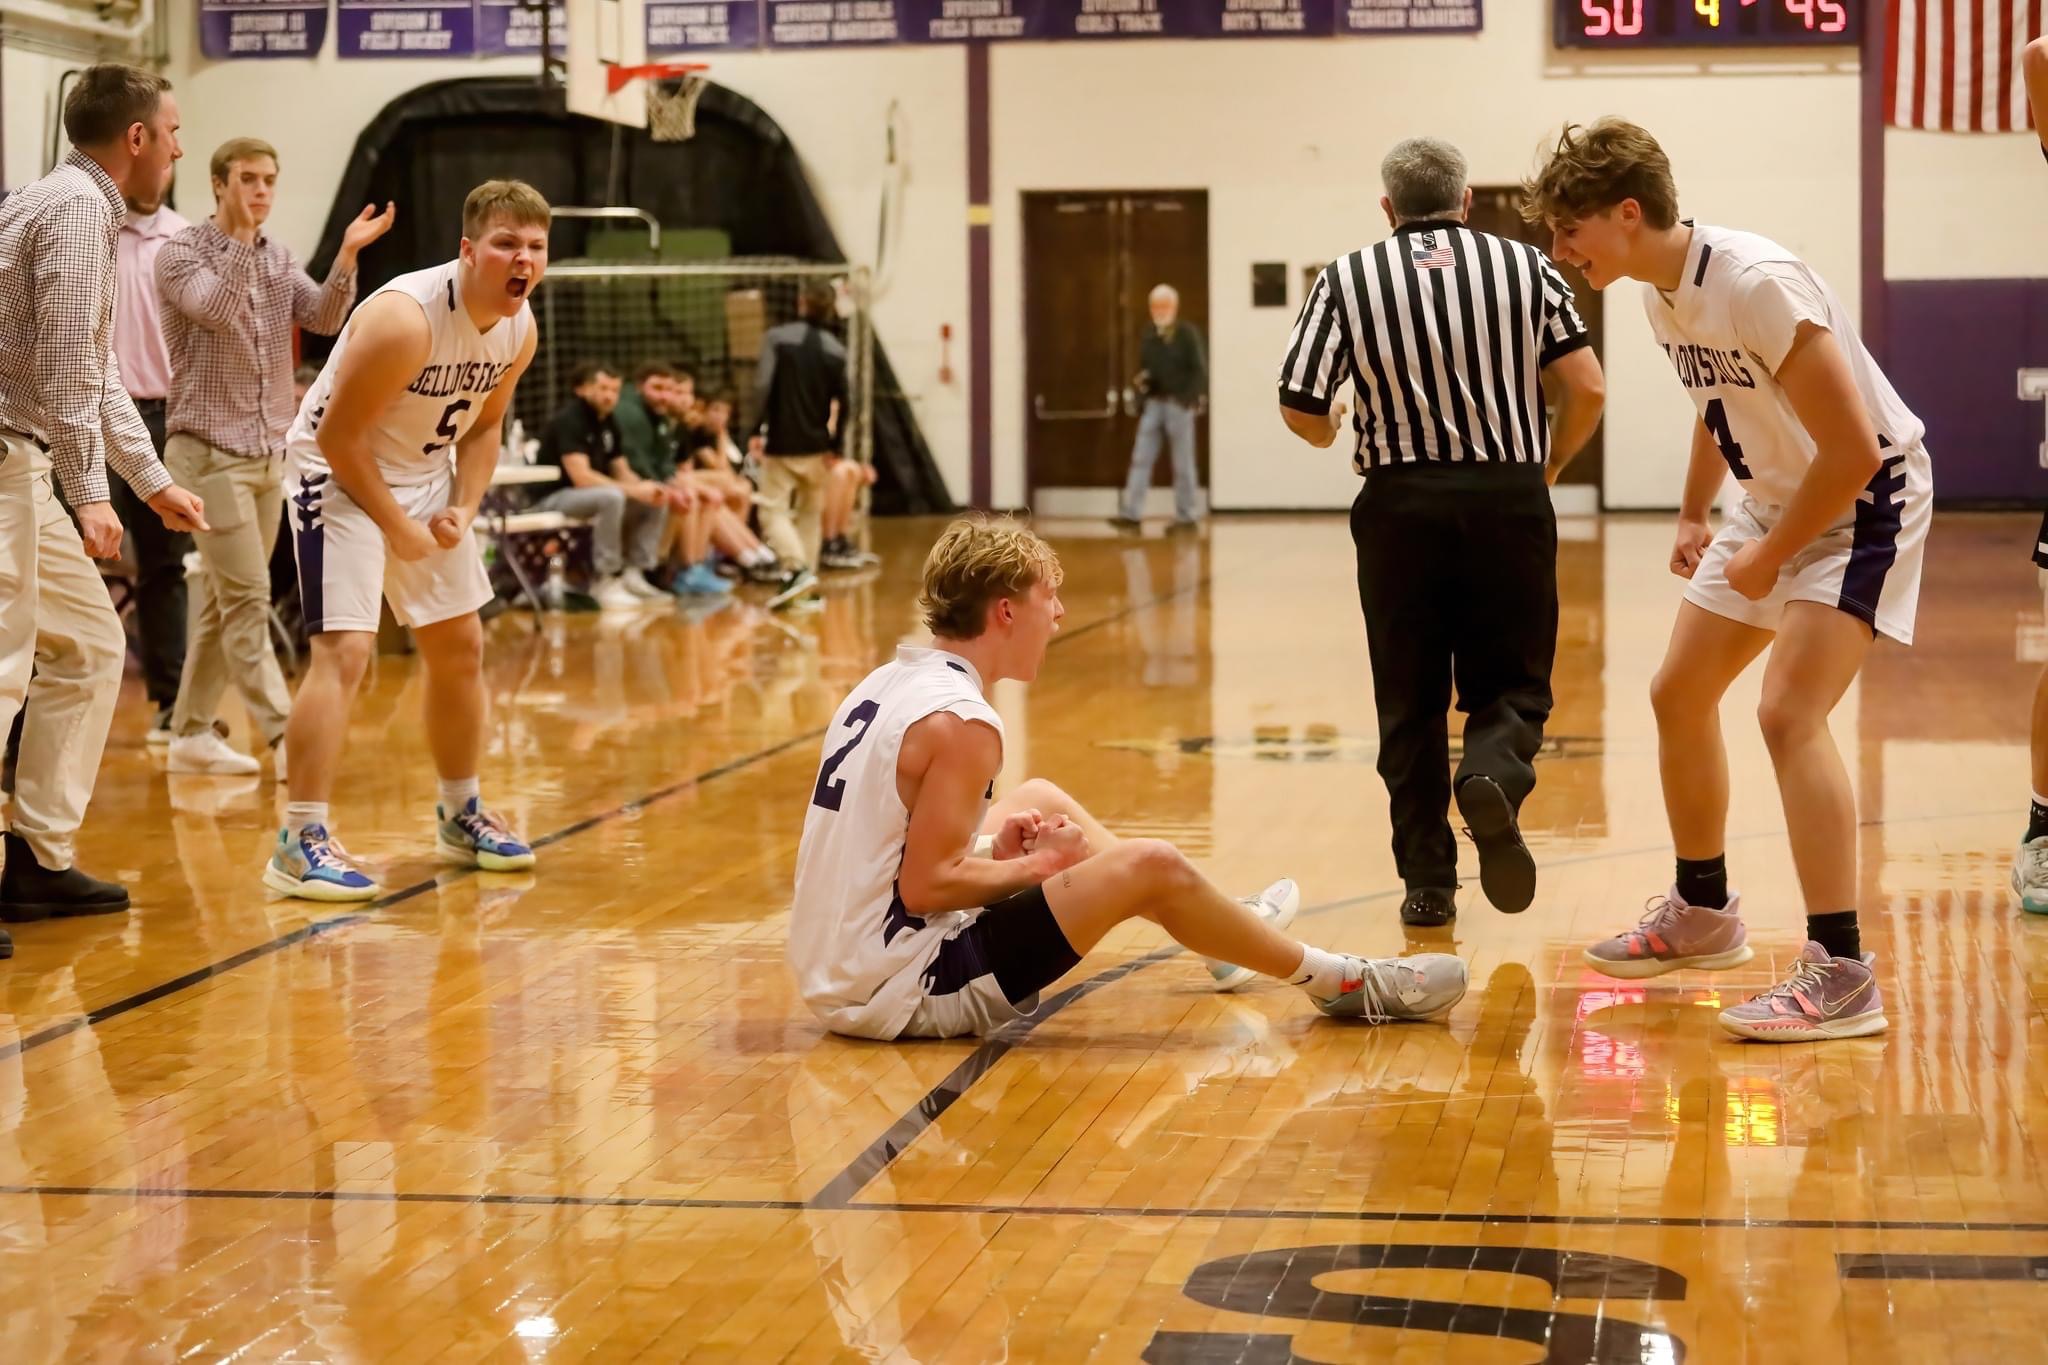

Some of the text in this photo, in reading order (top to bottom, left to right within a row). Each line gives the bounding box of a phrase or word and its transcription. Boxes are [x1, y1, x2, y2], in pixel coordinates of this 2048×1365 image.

[1582, 0, 1643, 36] 50
[1785, 0, 1846, 32] 45
[422, 399, 471, 455] 5
[1704, 398, 1754, 480] 4
[813, 699, 880, 812] 2
